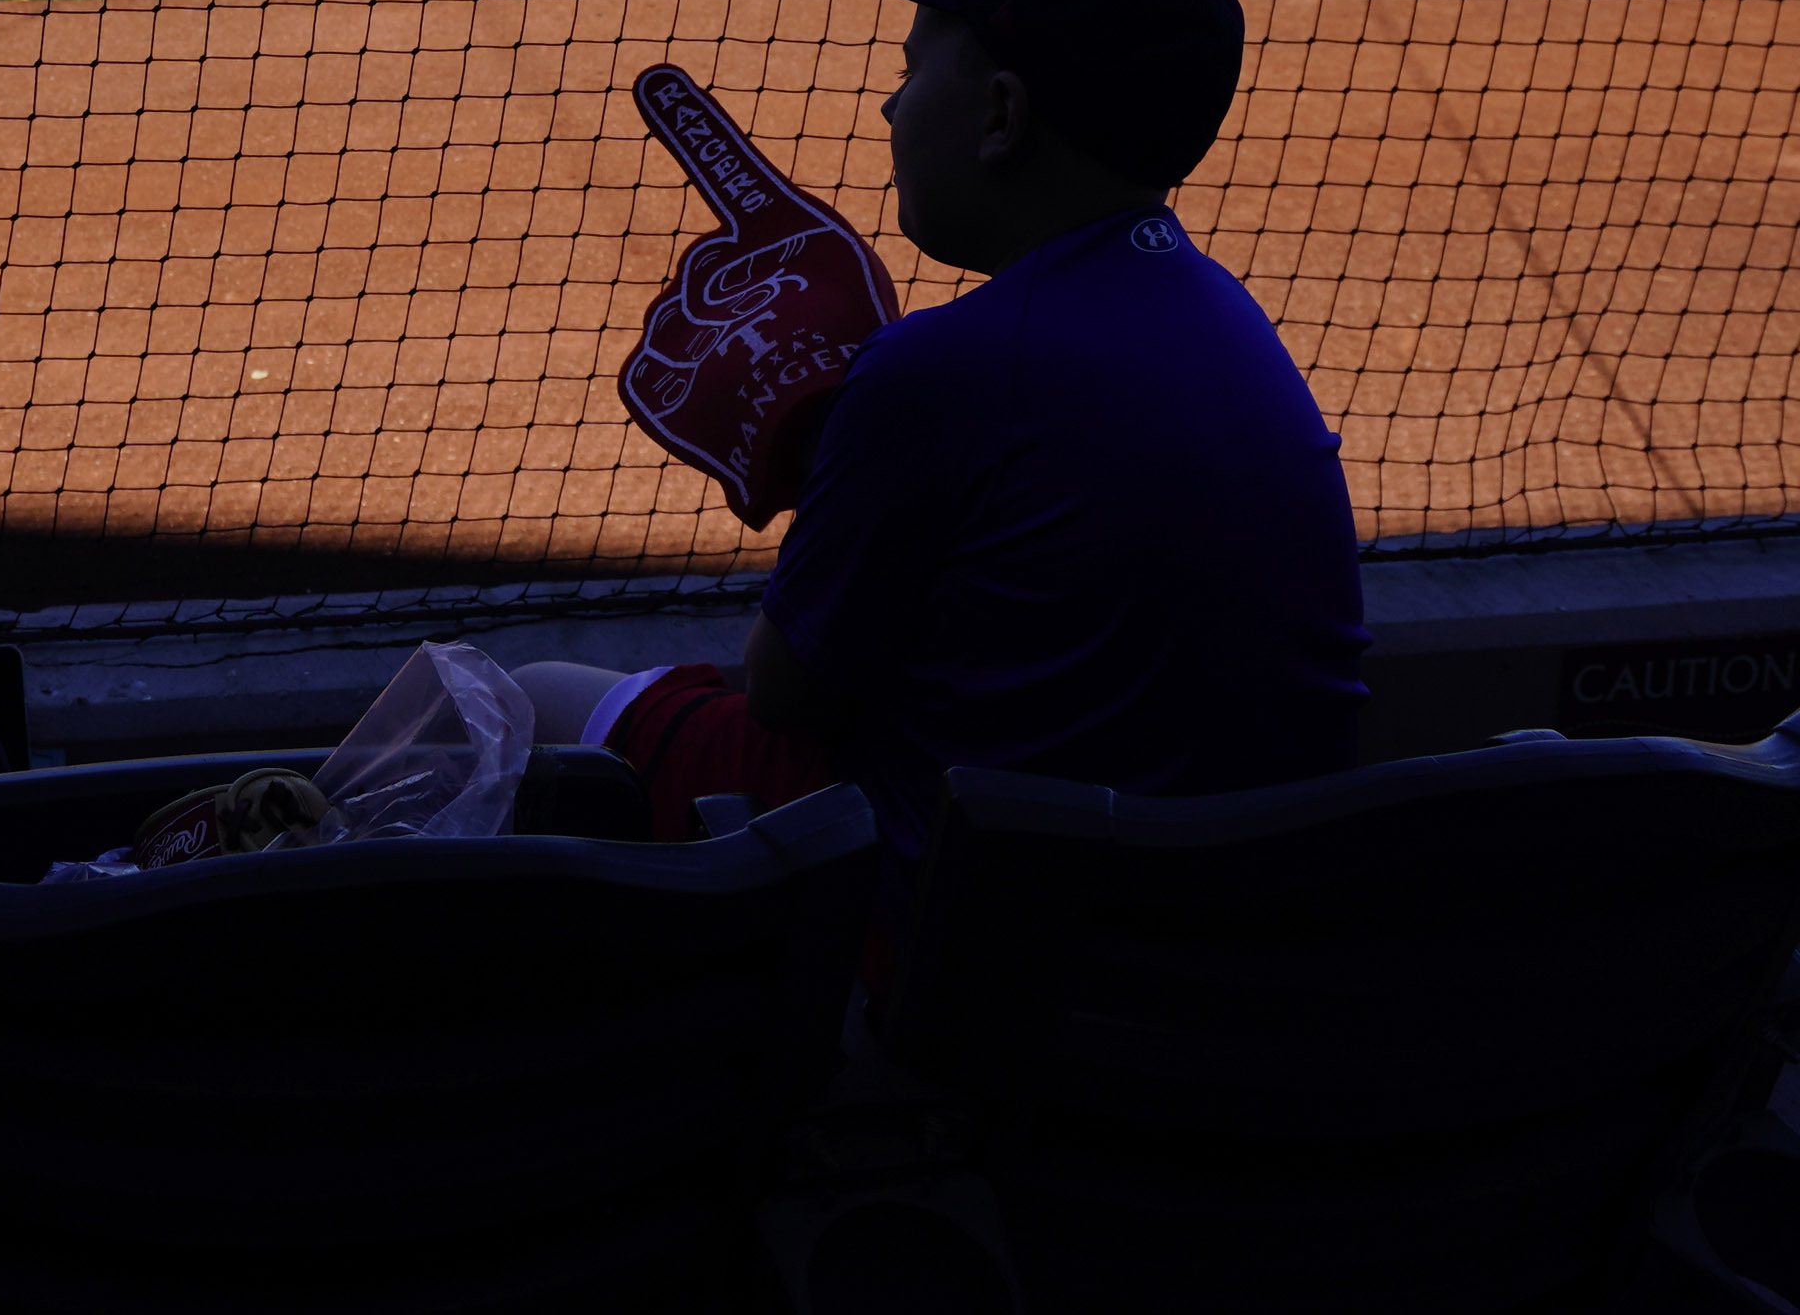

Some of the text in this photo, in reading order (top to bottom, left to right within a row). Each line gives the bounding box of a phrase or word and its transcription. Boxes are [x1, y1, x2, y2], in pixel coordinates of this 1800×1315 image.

[652, 81, 768, 214] RANGERS
[737, 331, 826, 400] TEXAS
[1572, 651, 1797, 705] CAUTION
